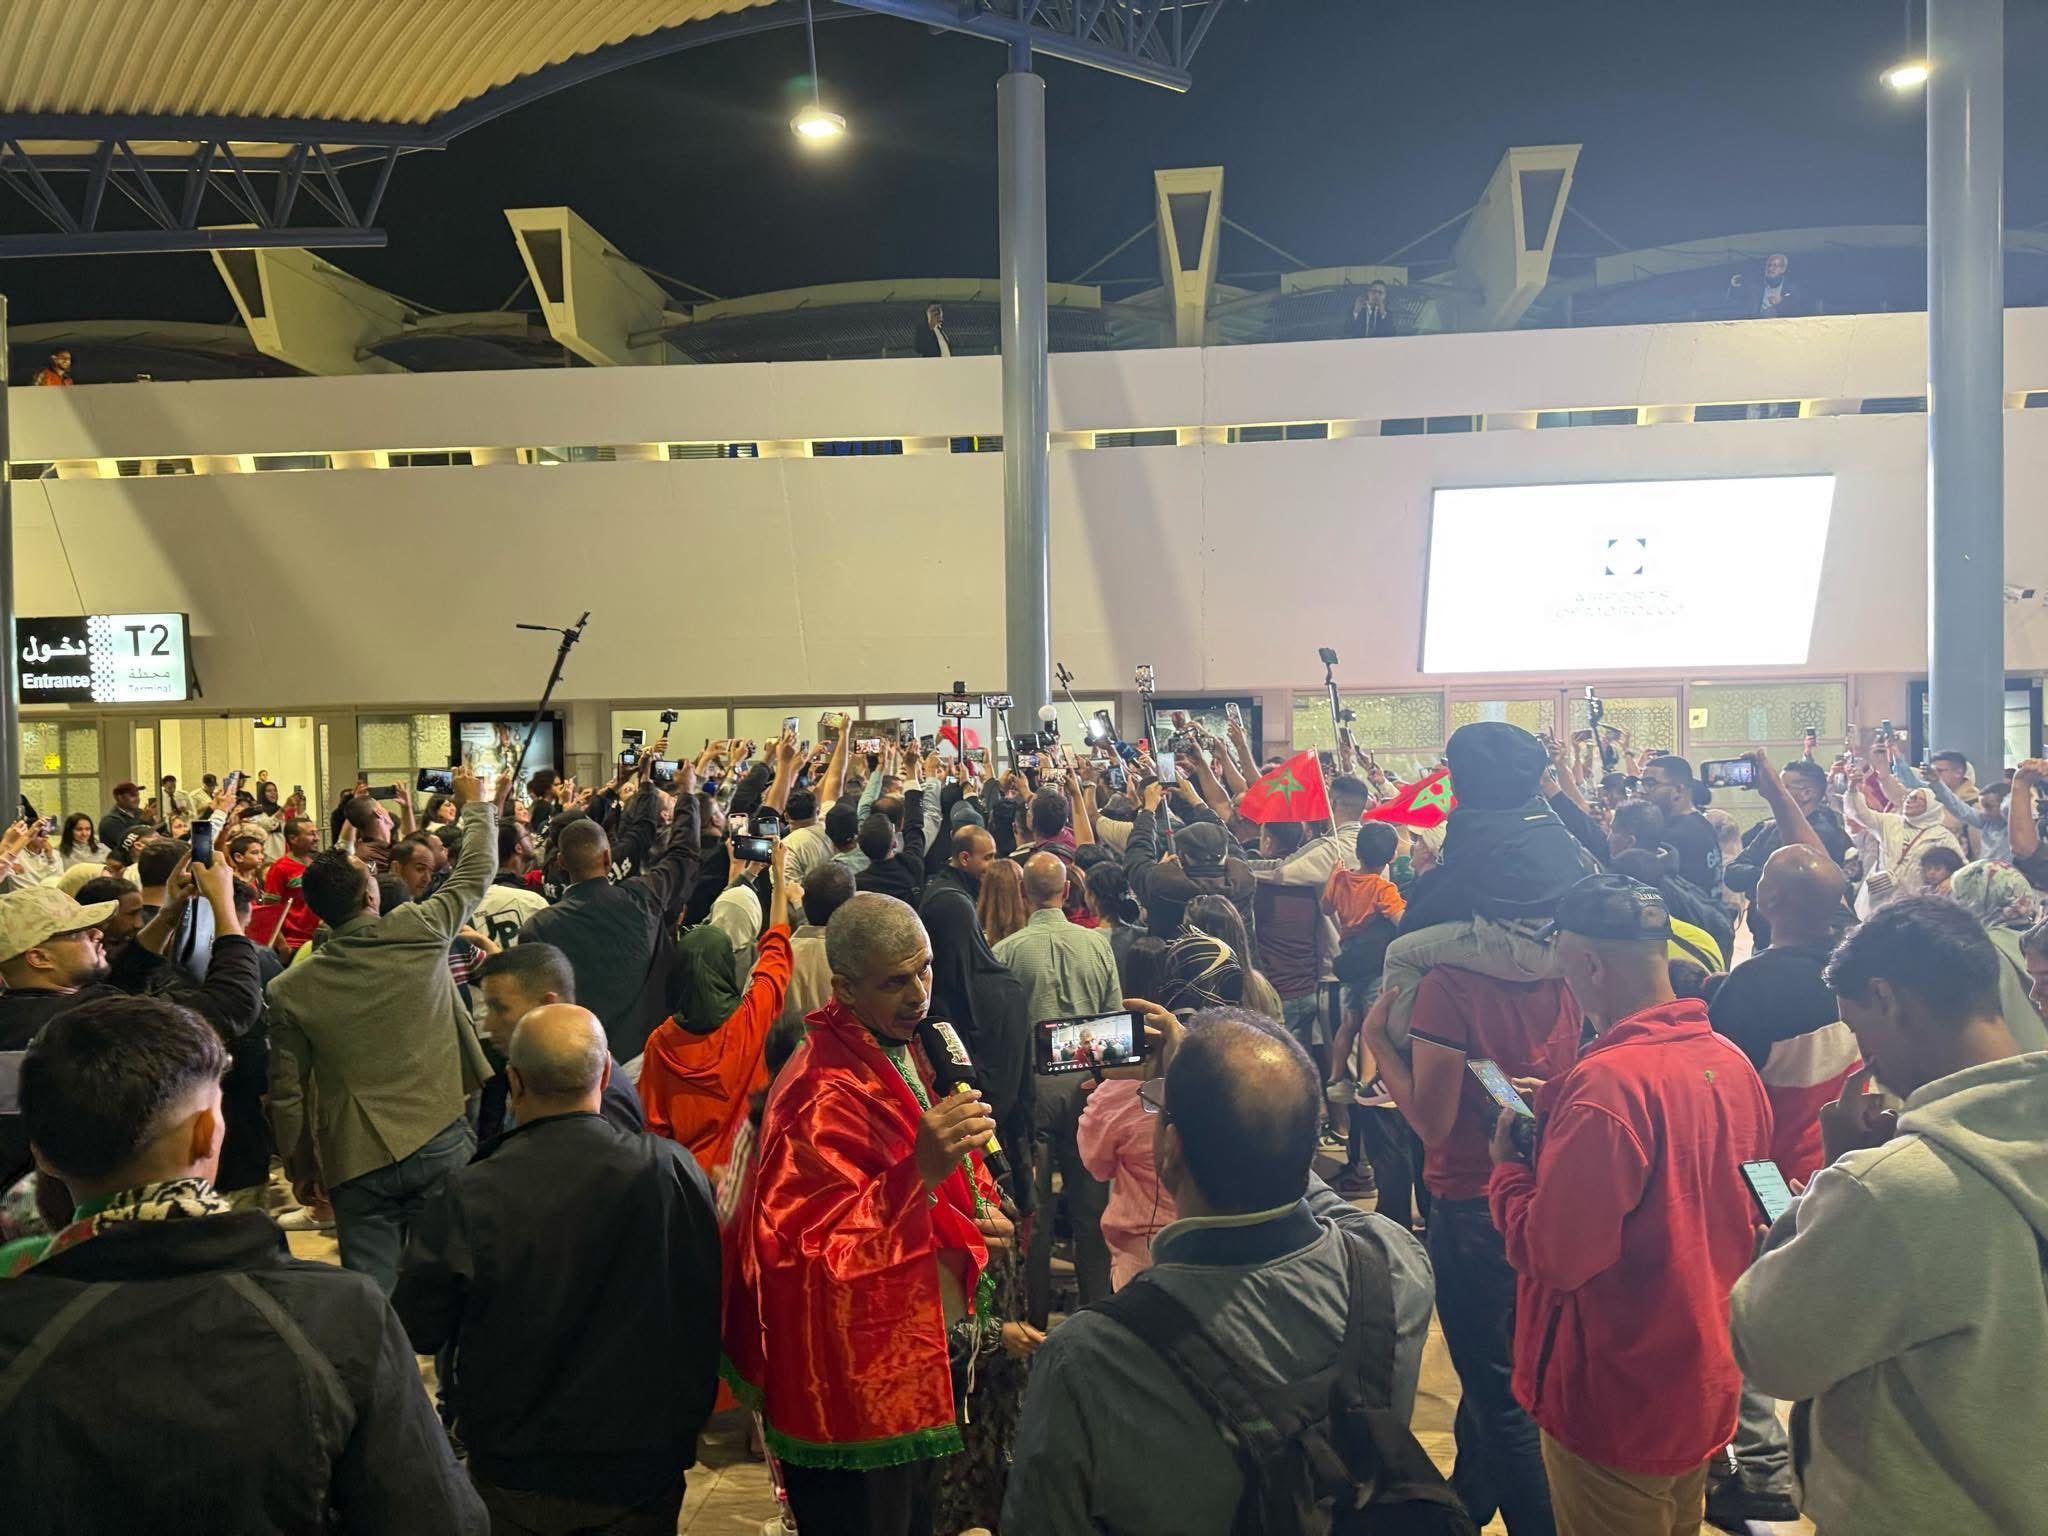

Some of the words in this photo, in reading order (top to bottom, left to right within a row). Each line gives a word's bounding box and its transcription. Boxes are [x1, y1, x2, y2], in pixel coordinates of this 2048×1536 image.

[22, 635, 87, 665] دخول
[124, 624, 170, 657] T2
[22, 673, 91, 689] Entrance
[128, 684, 172, 694] Terminal
